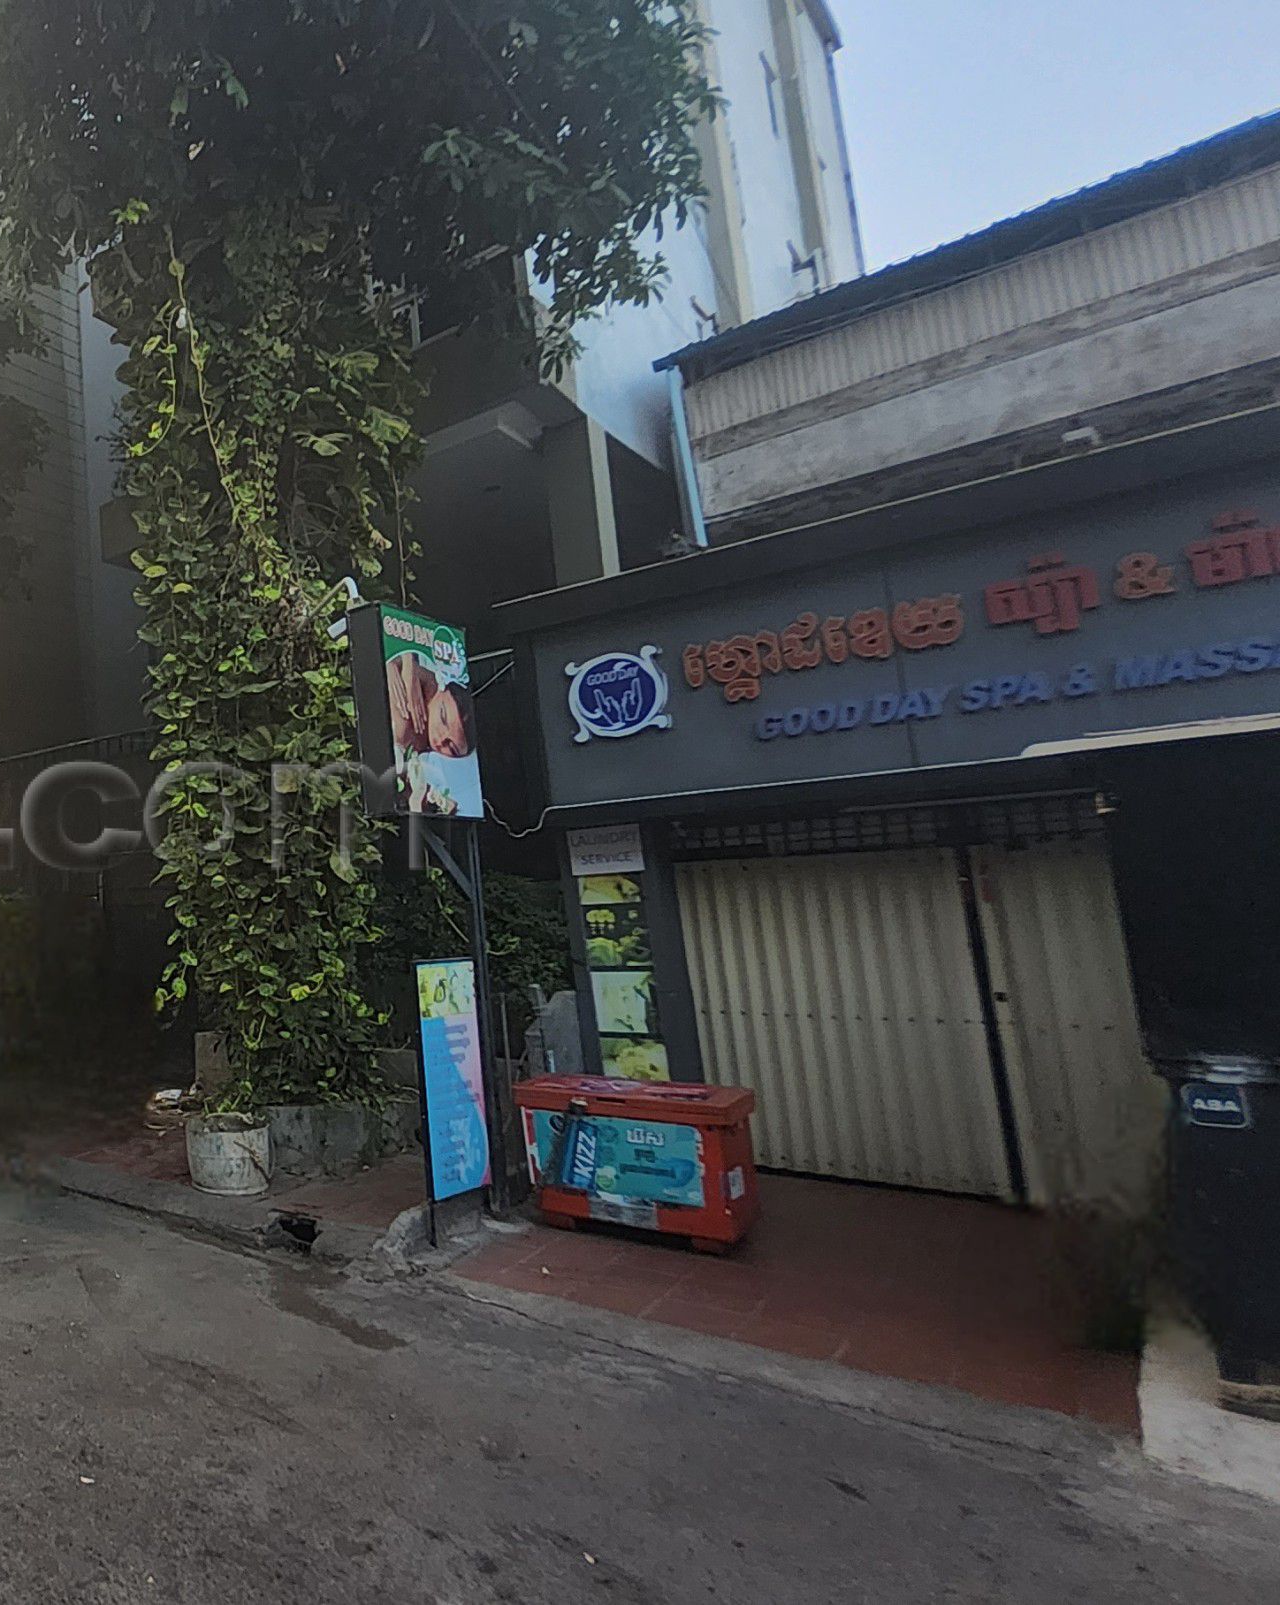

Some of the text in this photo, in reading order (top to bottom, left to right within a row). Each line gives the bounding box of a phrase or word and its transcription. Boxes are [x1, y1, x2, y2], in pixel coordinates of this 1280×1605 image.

[1113, 551, 1177, 600] &
[383, 615, 434, 648] GOOD DAY
[434, 639, 461, 664] SPA
[586, 665, 639, 687] GOOD DAY
[756, 636, 1280, 740] GOOD DAY SPA & MASS
[573, 1130, 597, 1181] KIZZ
